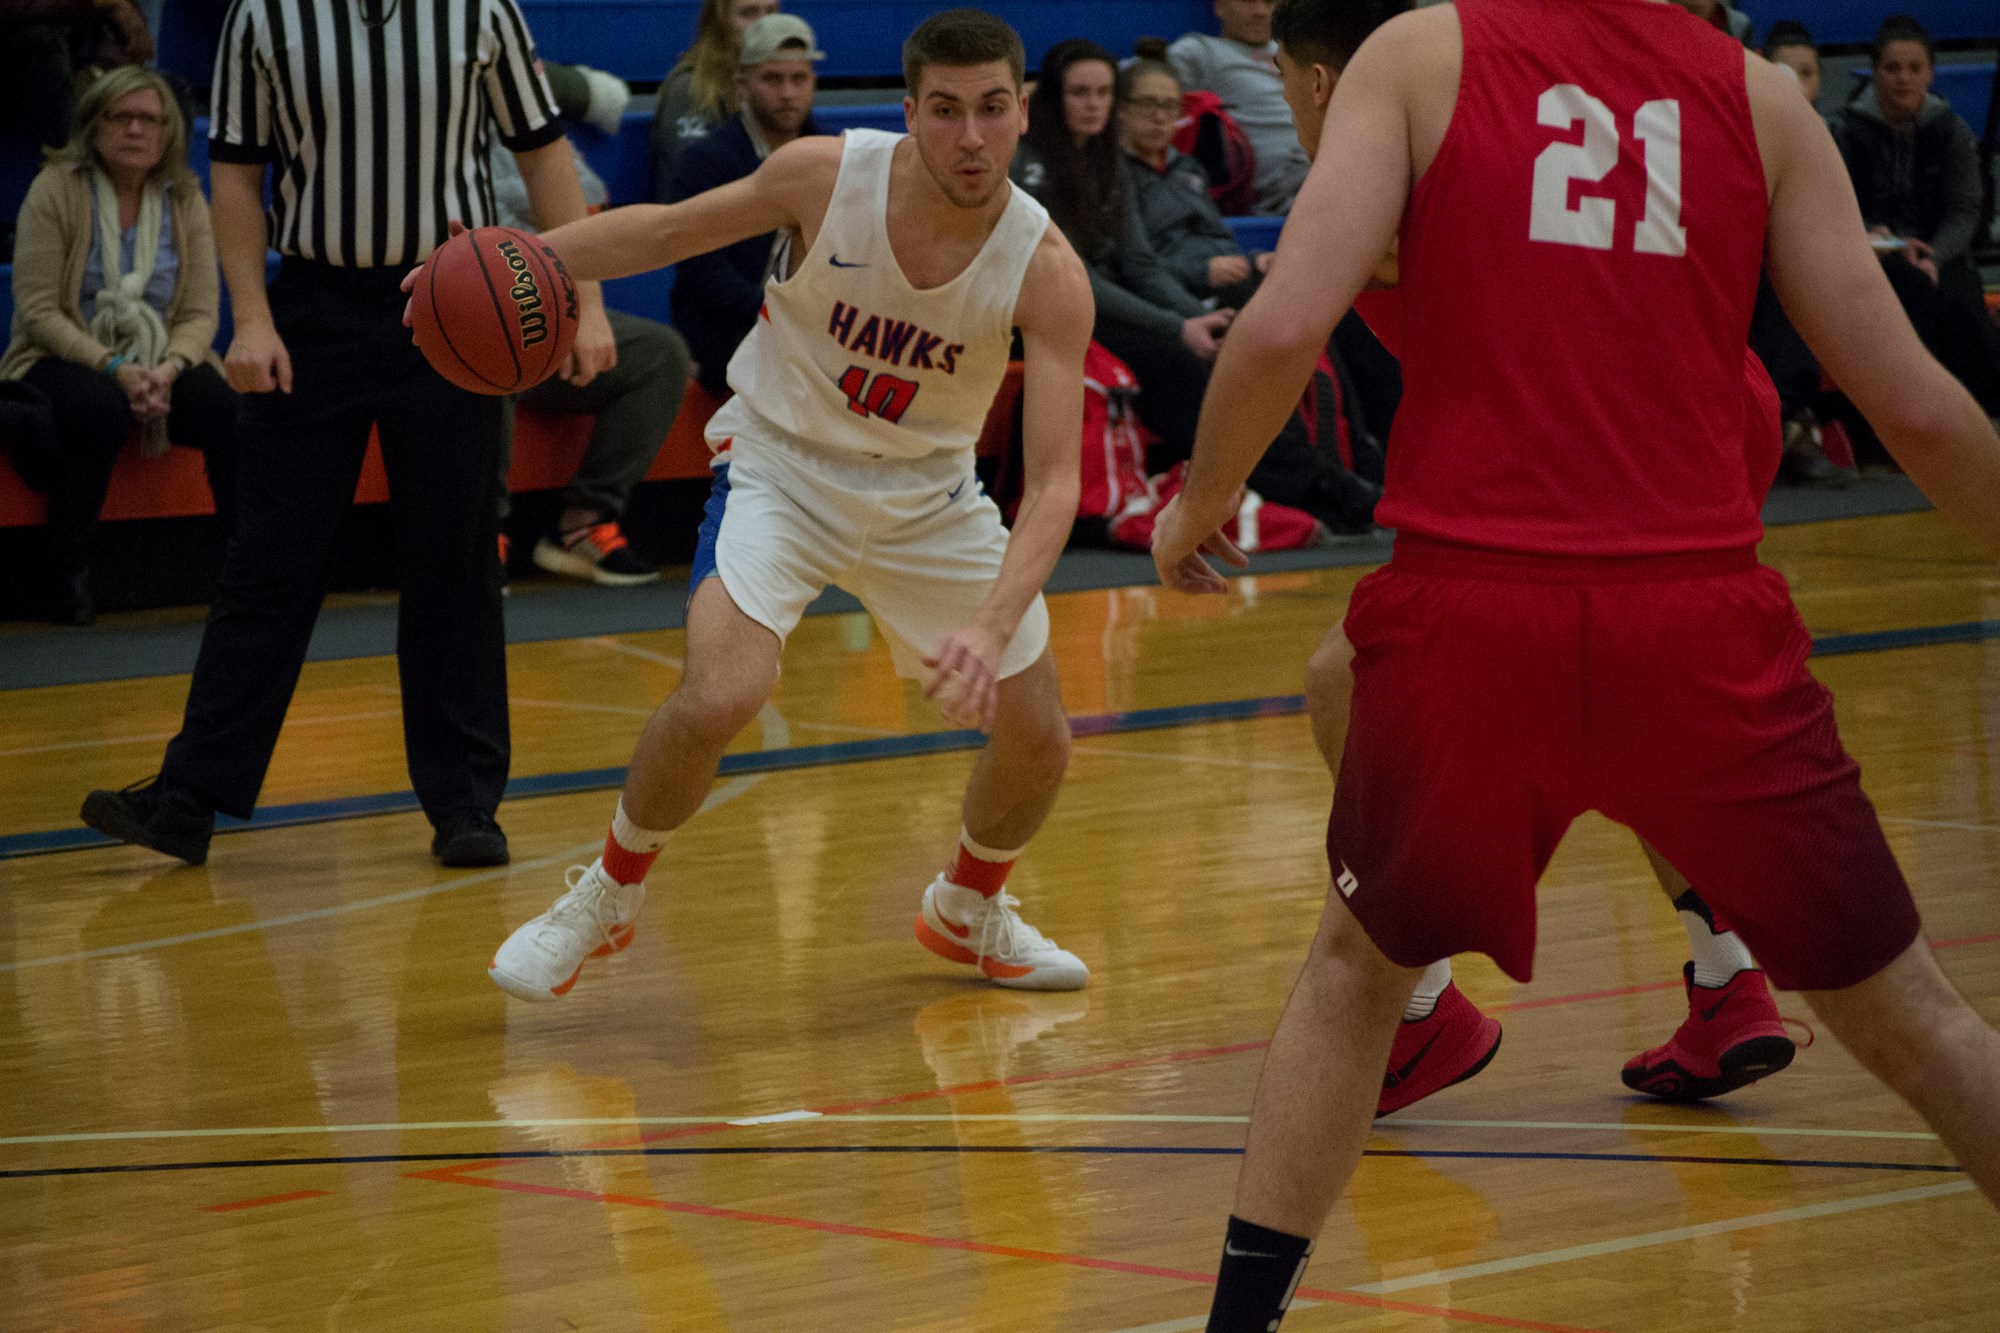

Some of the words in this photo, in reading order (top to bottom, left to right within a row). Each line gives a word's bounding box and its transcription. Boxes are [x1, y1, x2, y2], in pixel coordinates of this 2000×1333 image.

[1528, 82, 1687, 258] 21
[496, 239, 548, 350] Wilson
[829, 300, 965, 375] HAWKS
[838, 365, 920, 424] 10
